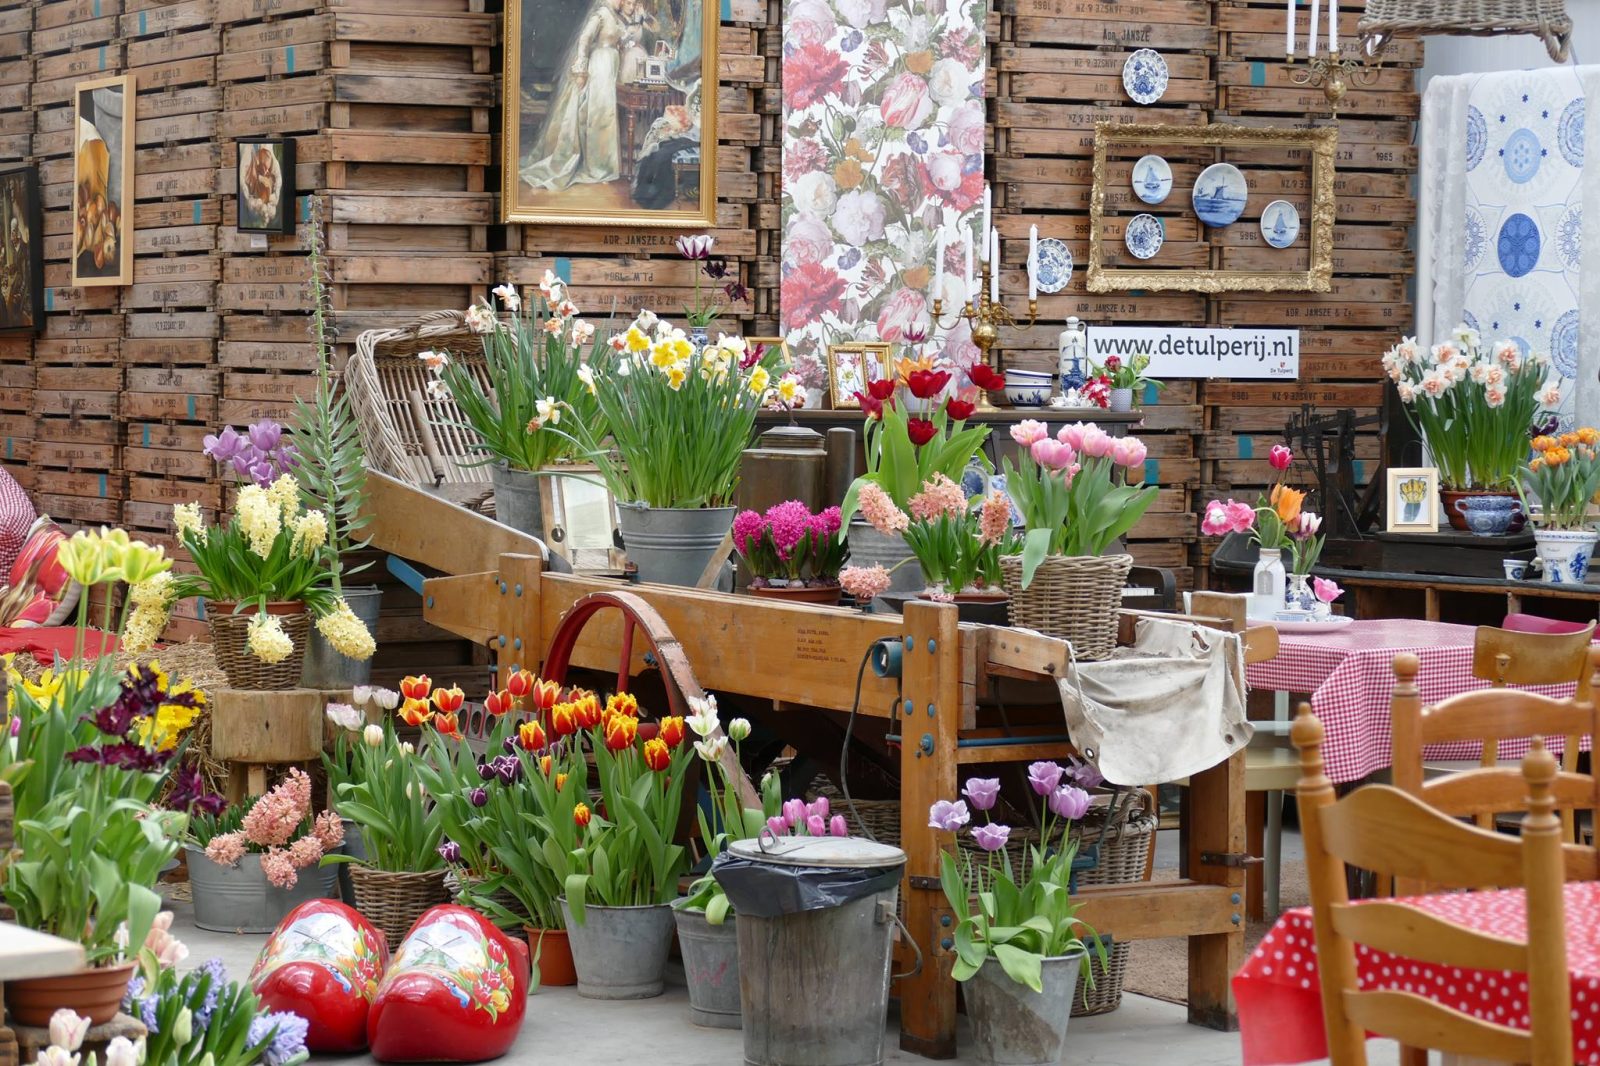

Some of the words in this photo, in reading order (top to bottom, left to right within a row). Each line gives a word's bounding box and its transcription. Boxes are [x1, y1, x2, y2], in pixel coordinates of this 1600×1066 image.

[1121, 29, 1150, 42] JANSZE
[625, 235, 657, 246] JANSZE
[660, 236, 666, 245] &
[1093, 304, 1118, 313] JANSZE
[1120, 304, 1126, 313] &
[1305, 308, 1332, 317] JANSZE
[1094, 333, 1294, 361] www.detulperij.nl
